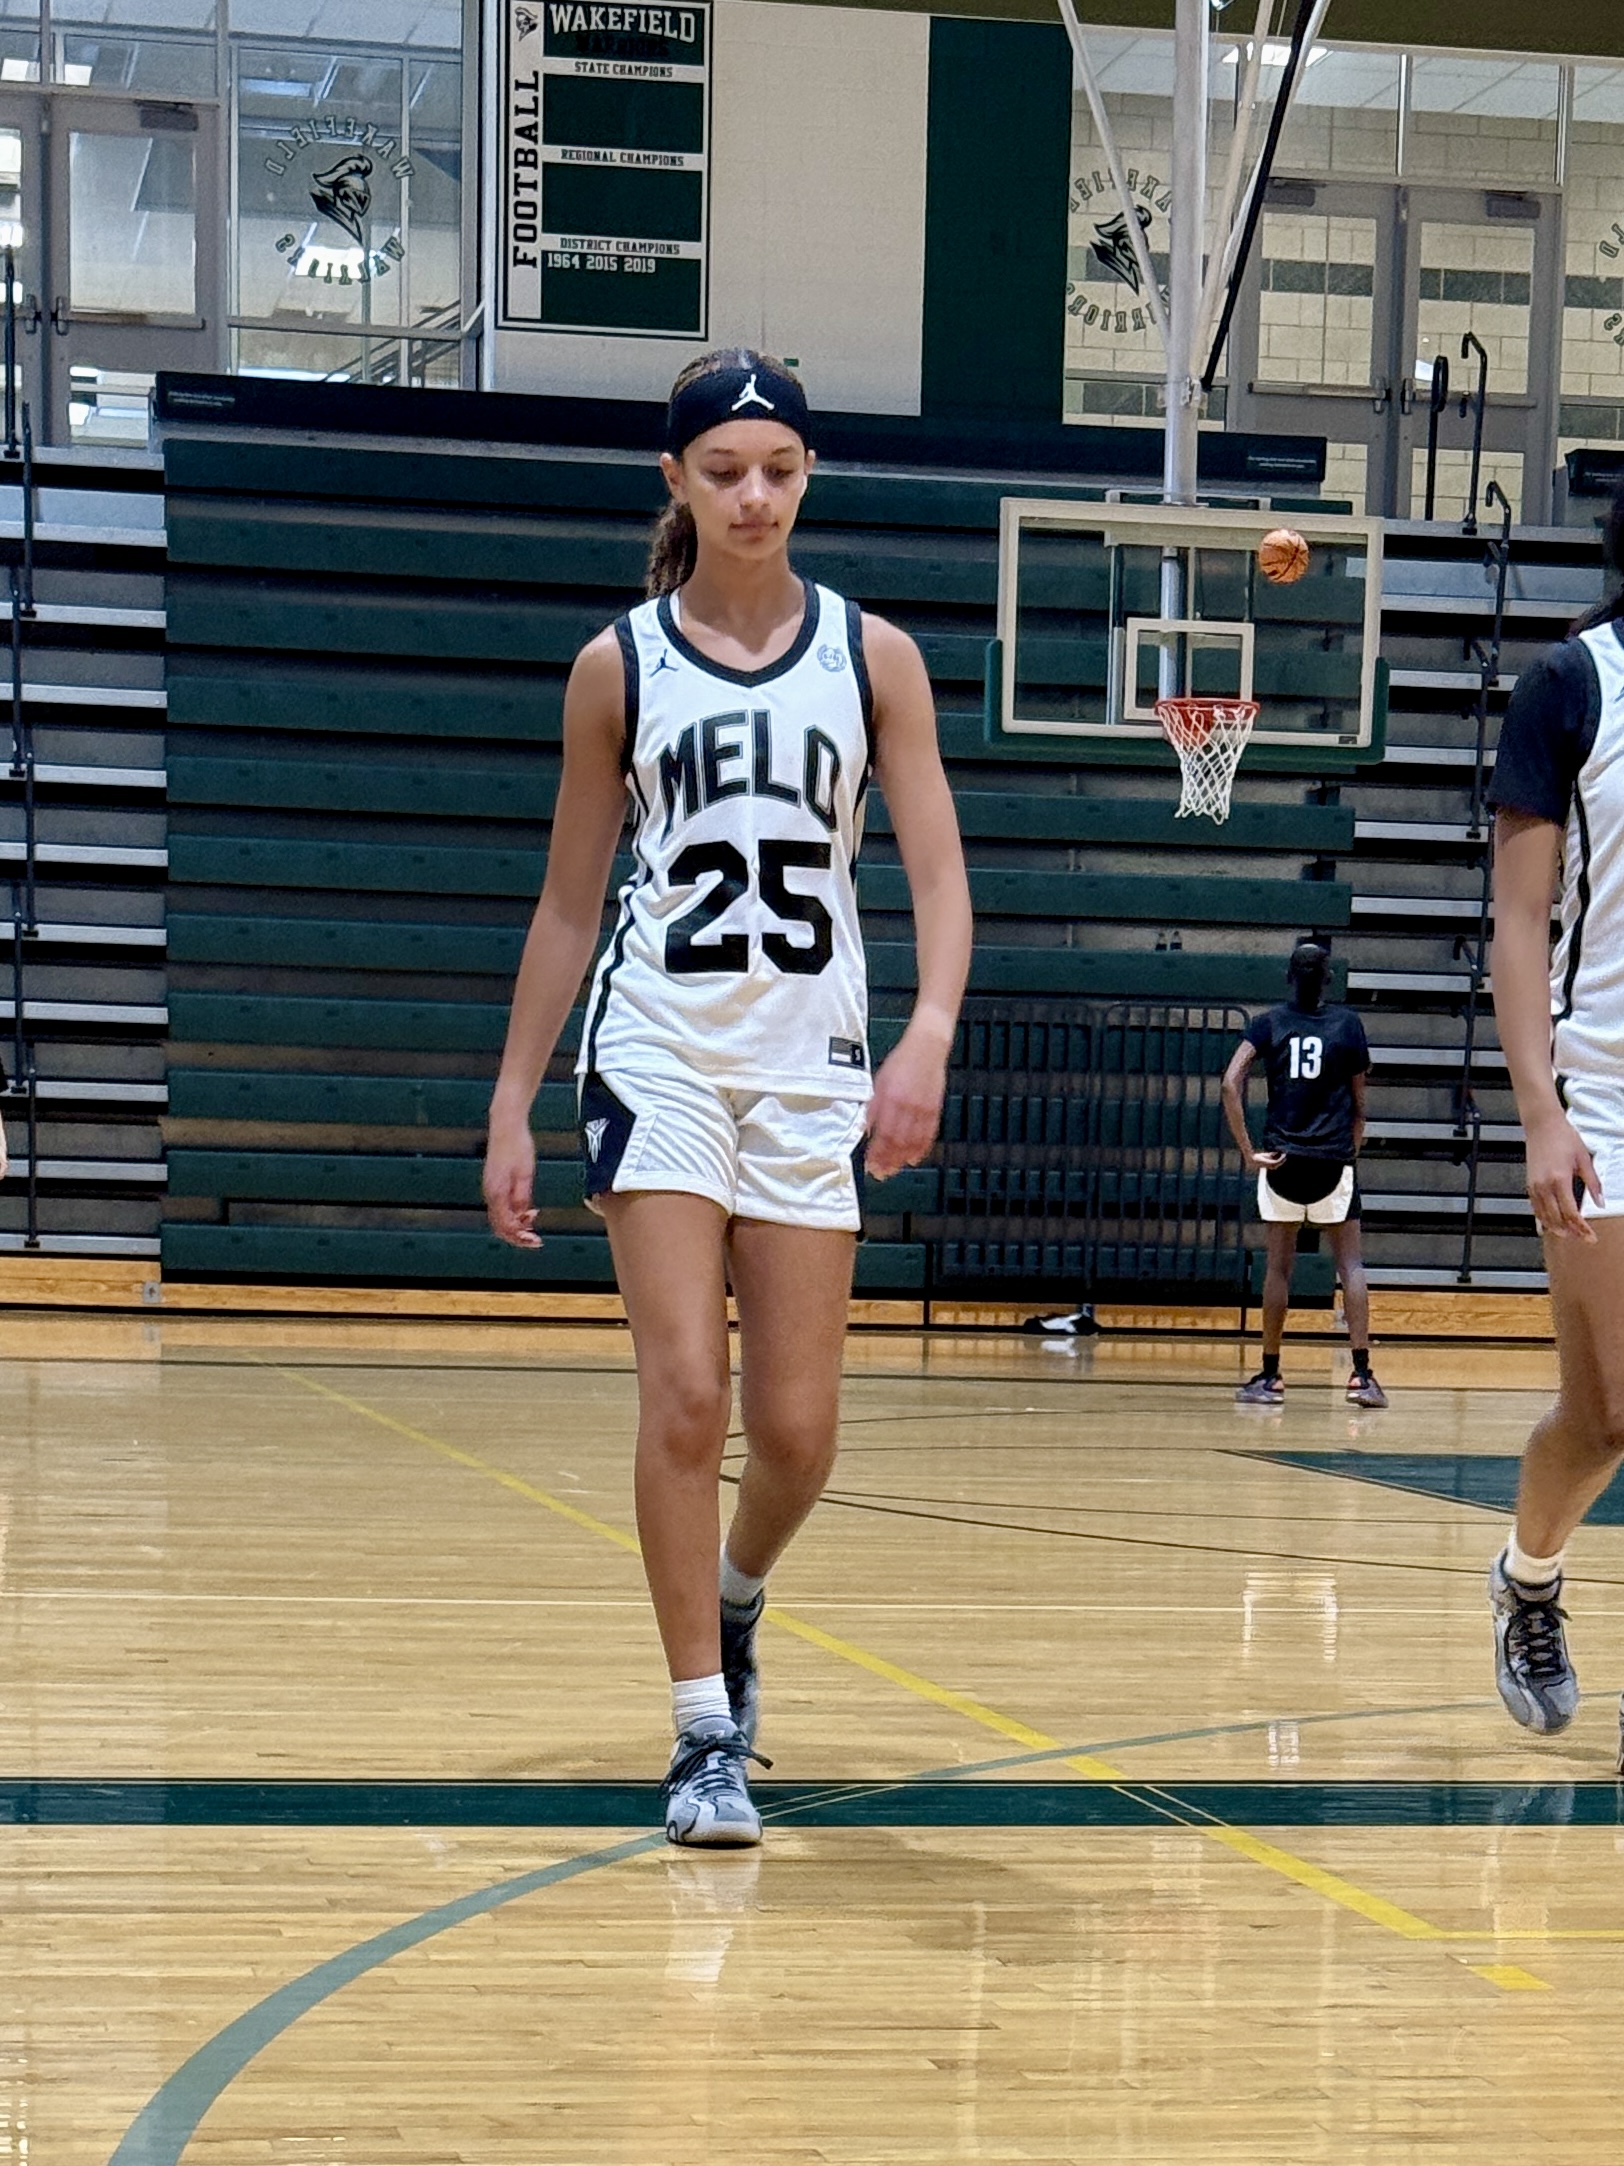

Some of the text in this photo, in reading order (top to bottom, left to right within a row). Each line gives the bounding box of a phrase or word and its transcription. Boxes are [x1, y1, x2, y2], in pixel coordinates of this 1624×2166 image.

[549, 4, 695, 43] WAKEFIELD
[574, 61, 673, 78] STATE CHAMPIONS
[513, 70, 539, 269] FOOTBALL
[560, 149, 684, 167] REGIONAL CHAMPIONS
[560, 237, 680, 255] DISTRICT CHAMPIONS
[547, 252, 656, 273] 1964 2015 2019
[664, 839, 834, 976] 25
[1289, 1036, 1323, 1079] 13
